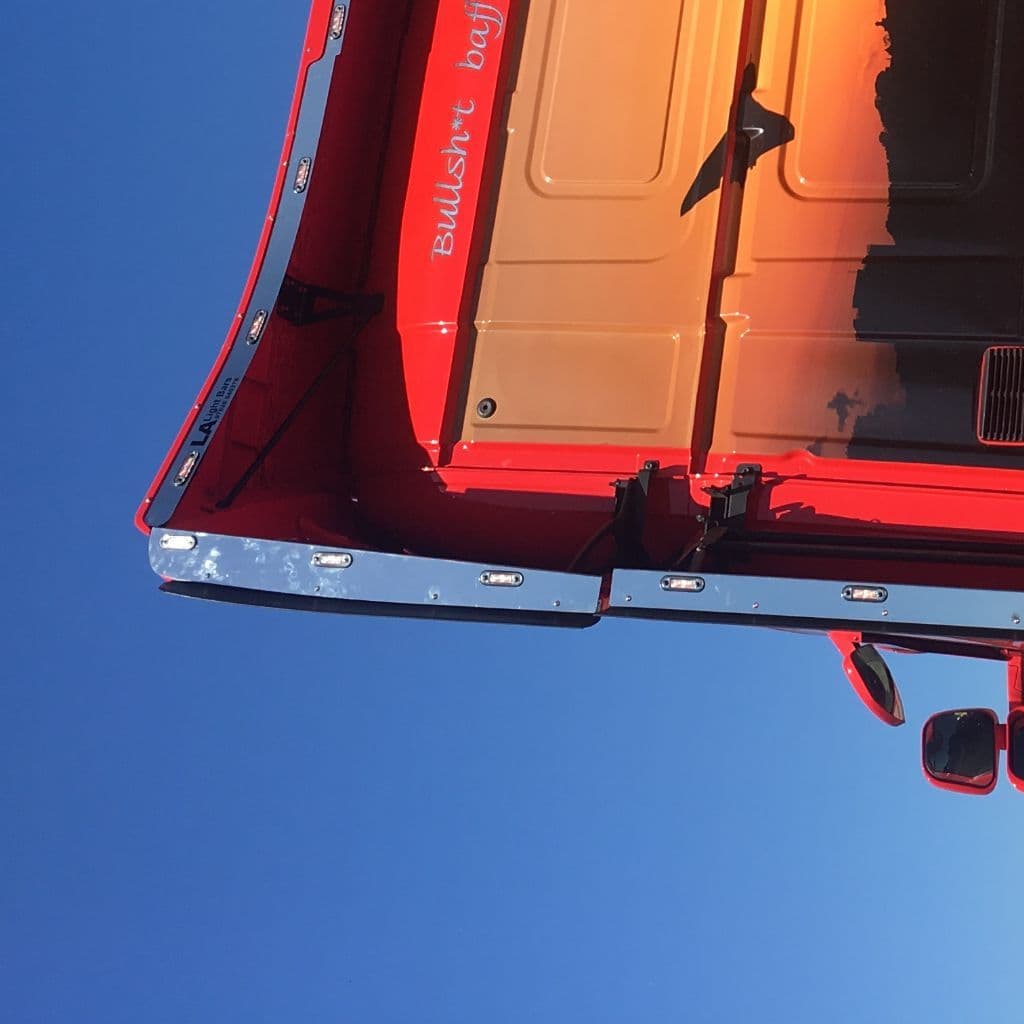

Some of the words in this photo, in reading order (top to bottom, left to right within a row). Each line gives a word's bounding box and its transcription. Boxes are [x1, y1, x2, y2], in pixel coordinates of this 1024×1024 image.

[215, 377, 232, 396] Bars
[203, 400, 222, 422] Light
[190, 420, 218, 446] LA
